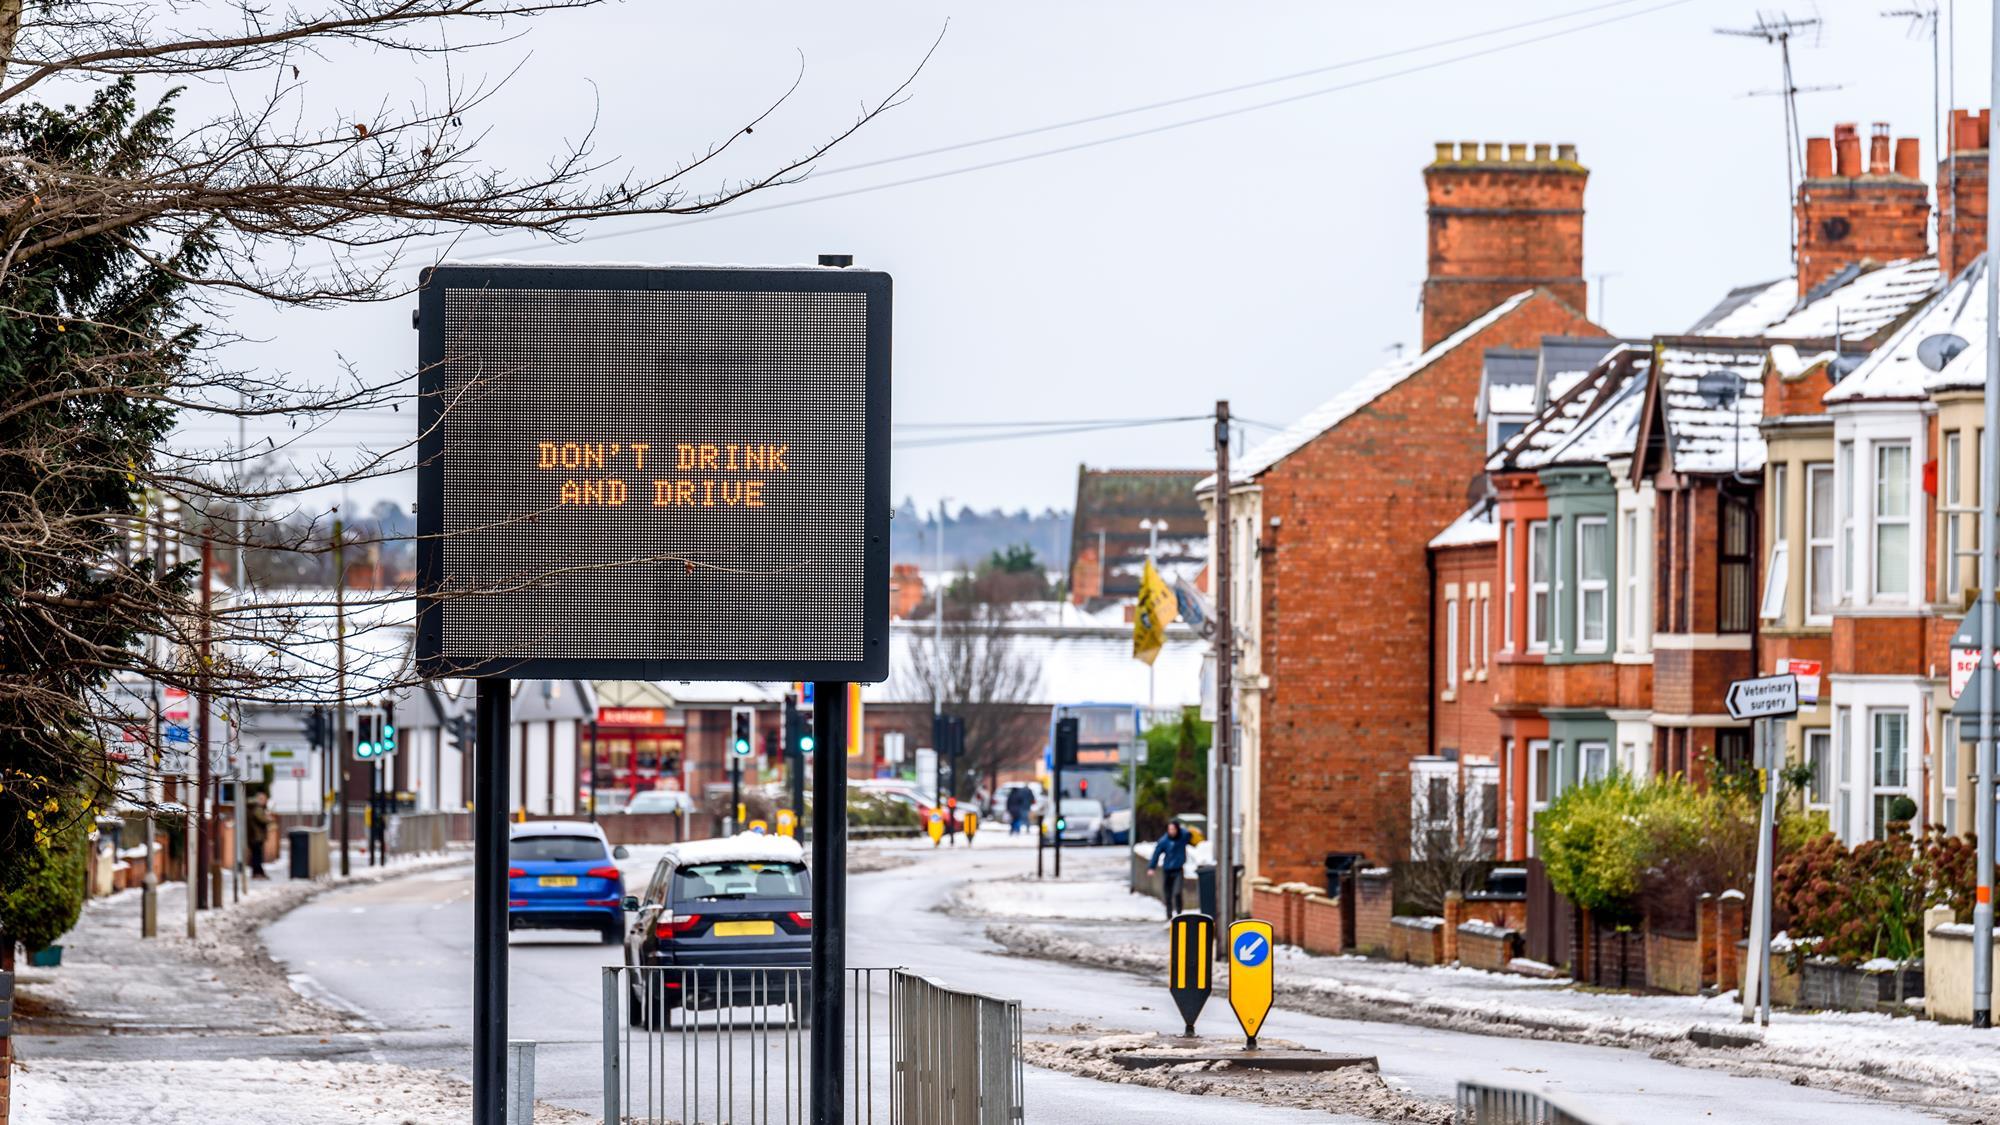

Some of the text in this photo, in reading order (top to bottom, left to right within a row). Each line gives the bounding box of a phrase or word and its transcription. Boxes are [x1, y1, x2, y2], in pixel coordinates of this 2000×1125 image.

[538, 443, 788, 471] DON'T DRINK
[560, 479, 764, 507] AND DRIVE
[1744, 683, 1793, 697] Veterinary
[1751, 698, 1787, 711] surgery
